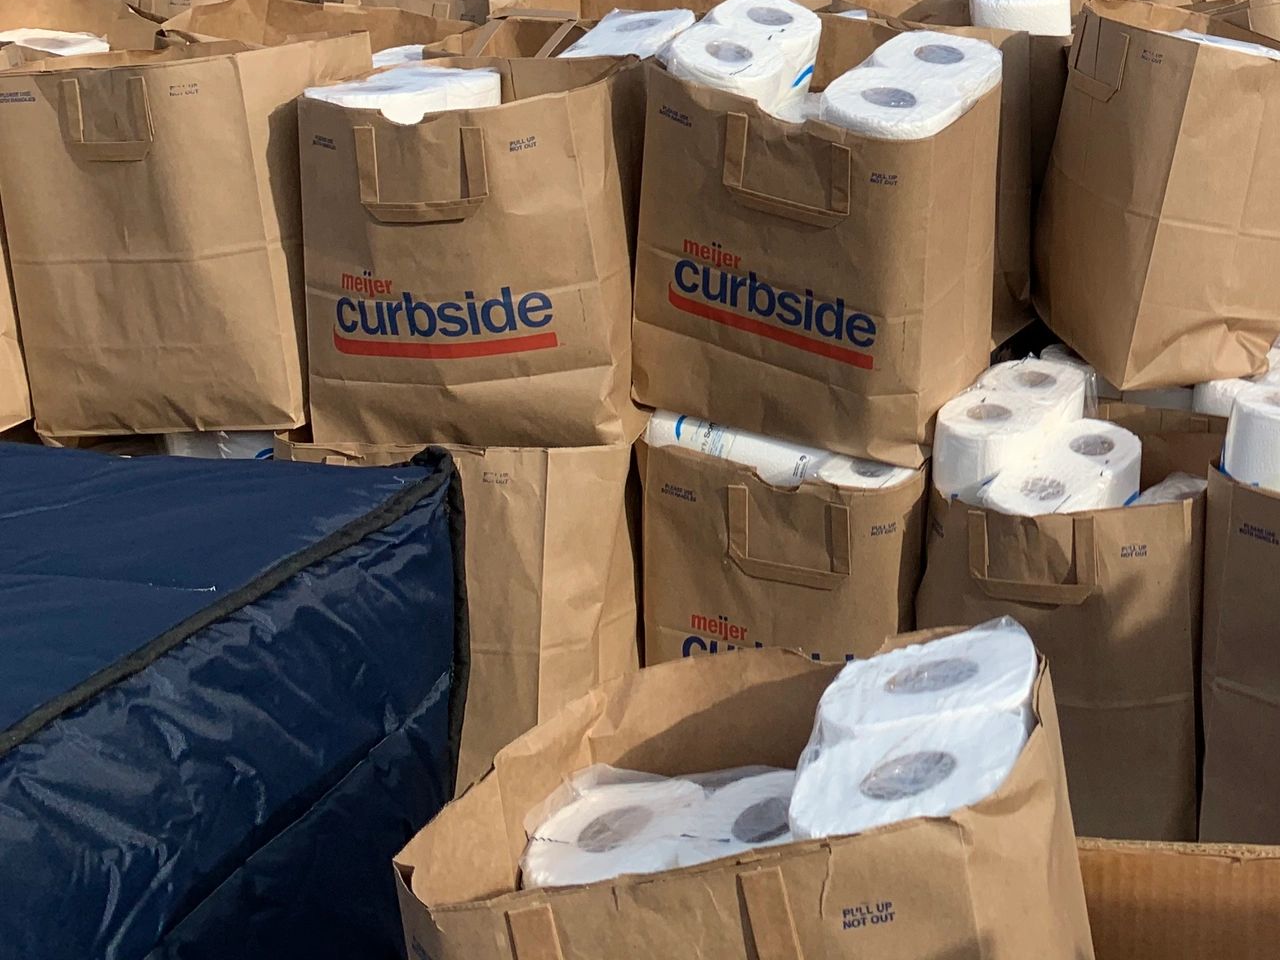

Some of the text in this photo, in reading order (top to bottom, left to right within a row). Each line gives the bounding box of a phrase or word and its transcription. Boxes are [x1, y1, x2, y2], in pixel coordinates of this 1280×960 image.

[509, 138, 525, 147] PULL
[524, 141, 537, 150] OUT
[682, 239, 742, 269] meijer
[341, 270, 393, 298] meijer
[336, 286, 553, 337] curbside
[674, 259, 876, 348] curbside
[691, 614, 748, 641] meijer
[842, 901, 893, 919] PULL UP
[842, 911, 896, 930] NOT OUT
